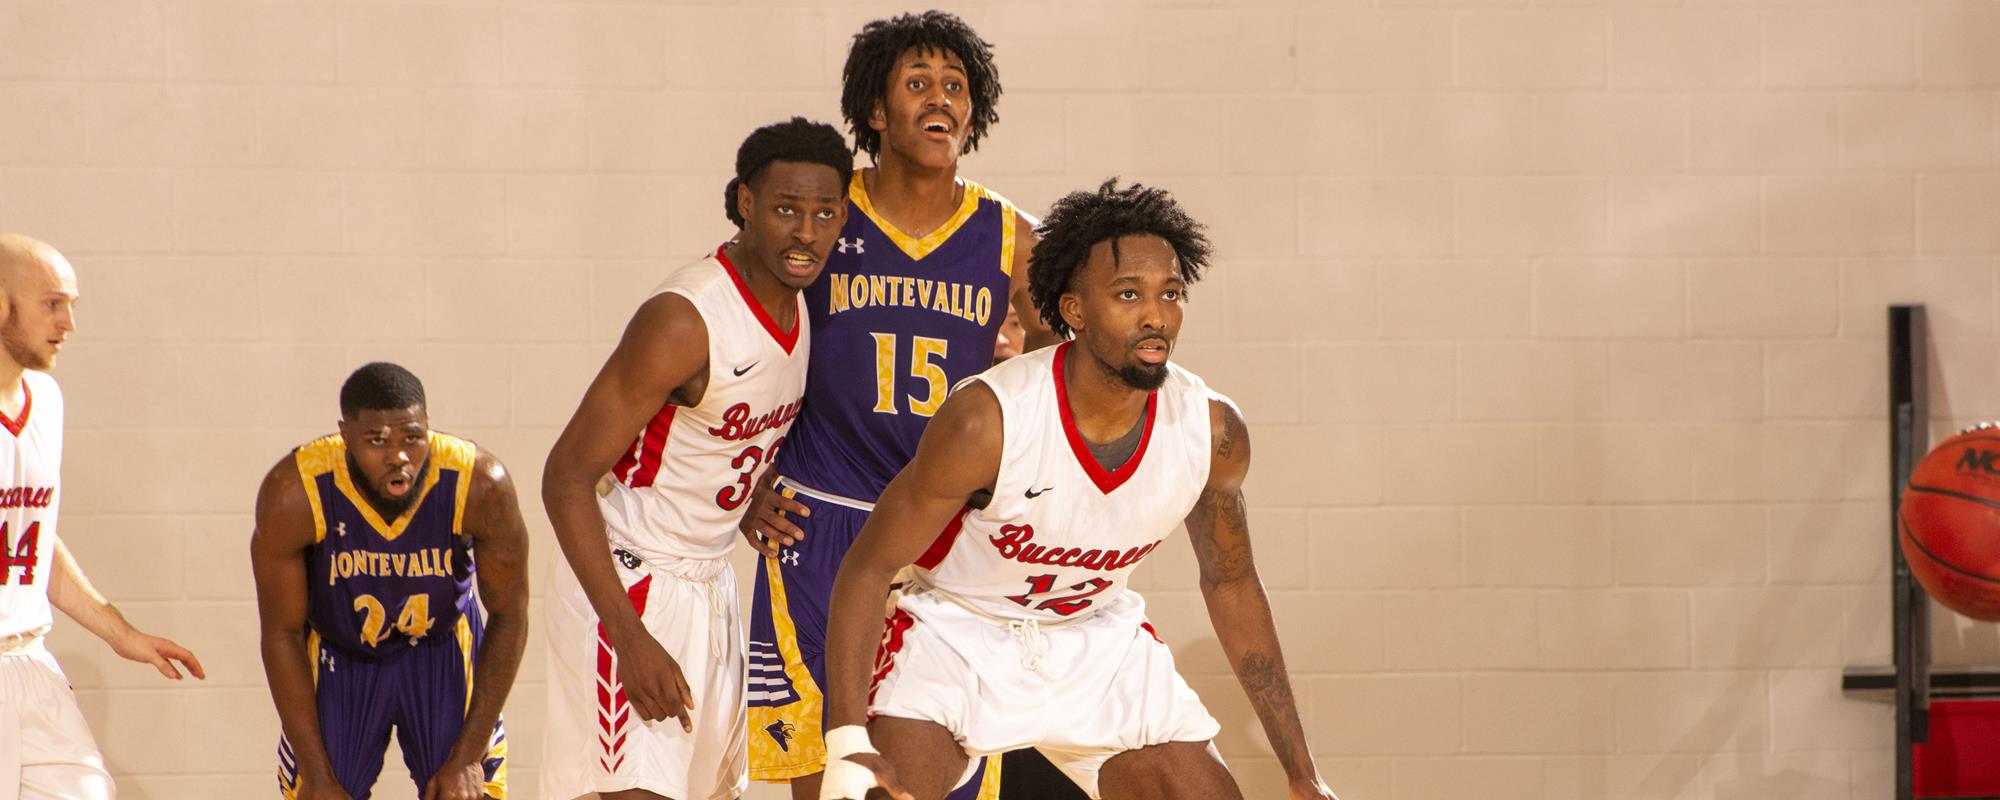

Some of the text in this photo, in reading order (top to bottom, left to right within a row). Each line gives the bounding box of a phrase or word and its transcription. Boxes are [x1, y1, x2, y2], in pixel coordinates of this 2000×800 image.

[829, 273, 992, 327] MONTEVALLO
[869, 332, 949, 417] 15
[353, 593, 436, 648] 24
[1004, 574, 1113, 616] 12
